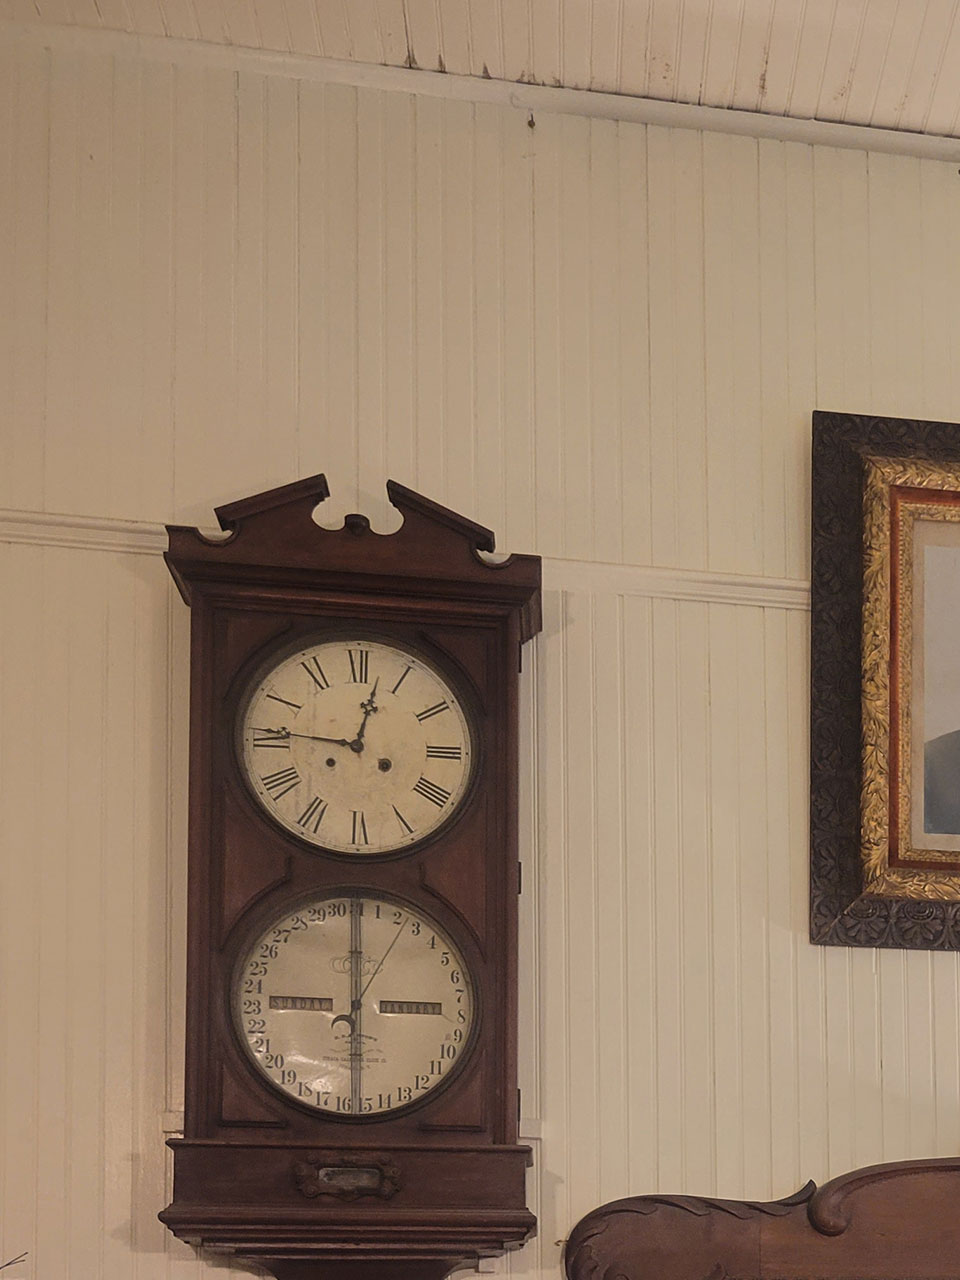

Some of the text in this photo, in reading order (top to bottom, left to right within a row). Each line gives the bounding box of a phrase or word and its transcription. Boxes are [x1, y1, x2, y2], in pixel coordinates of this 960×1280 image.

[347, 649, 370, 684] XII
[299, 655, 332, 695] XI
[413, 697, 450, 725] II
[426, 744, 462, 761] III
[260, 766, 302, 802] VIII
[412, 776, 451, 809] IIII
[297, 796, 328, 834] VII
[349, 810, 372, 845] VI
[308, 908, 326, 922] 29
[328, 902, 346, 918] 30
[375, 904, 380, 919] 1
[291, 916, 308, 931] 28
[393, 912, 402, 925] 2
[273, 928, 291, 944] 27
[412, 922, 421, 936] 3
[427, 936, 437, 950] 4
[260, 944, 278, 959] 26
[441, 952, 450, 966] 5
[250, 961, 268, 976] 25
[451, 970, 460, 984] 6
[244, 979, 263, 994] 24
[455, 989, 464, 1004] 7
[243, 1000, 262, 1015] 23
[456, 1010, 466, 1024] 8
[248, 1019, 266, 1034] 22
[454, 1029, 462, 1043] 9
[255, 1038, 270, 1054] 21
[440, 1044, 456, 1060] 10
[265, 1054, 284, 1070] 20
[430, 1060, 443, 1075] 11
[281, 1070, 297, 1086] 19
[414, 1075, 430, 1090] 12
[298, 1082, 313, 1097] 18
[397, 1086, 412, 1102] 13
[316, 1091, 330, 1106] 17
[336, 1096, 351, 1112] 16
[378, 1094, 392, 1109] 14
